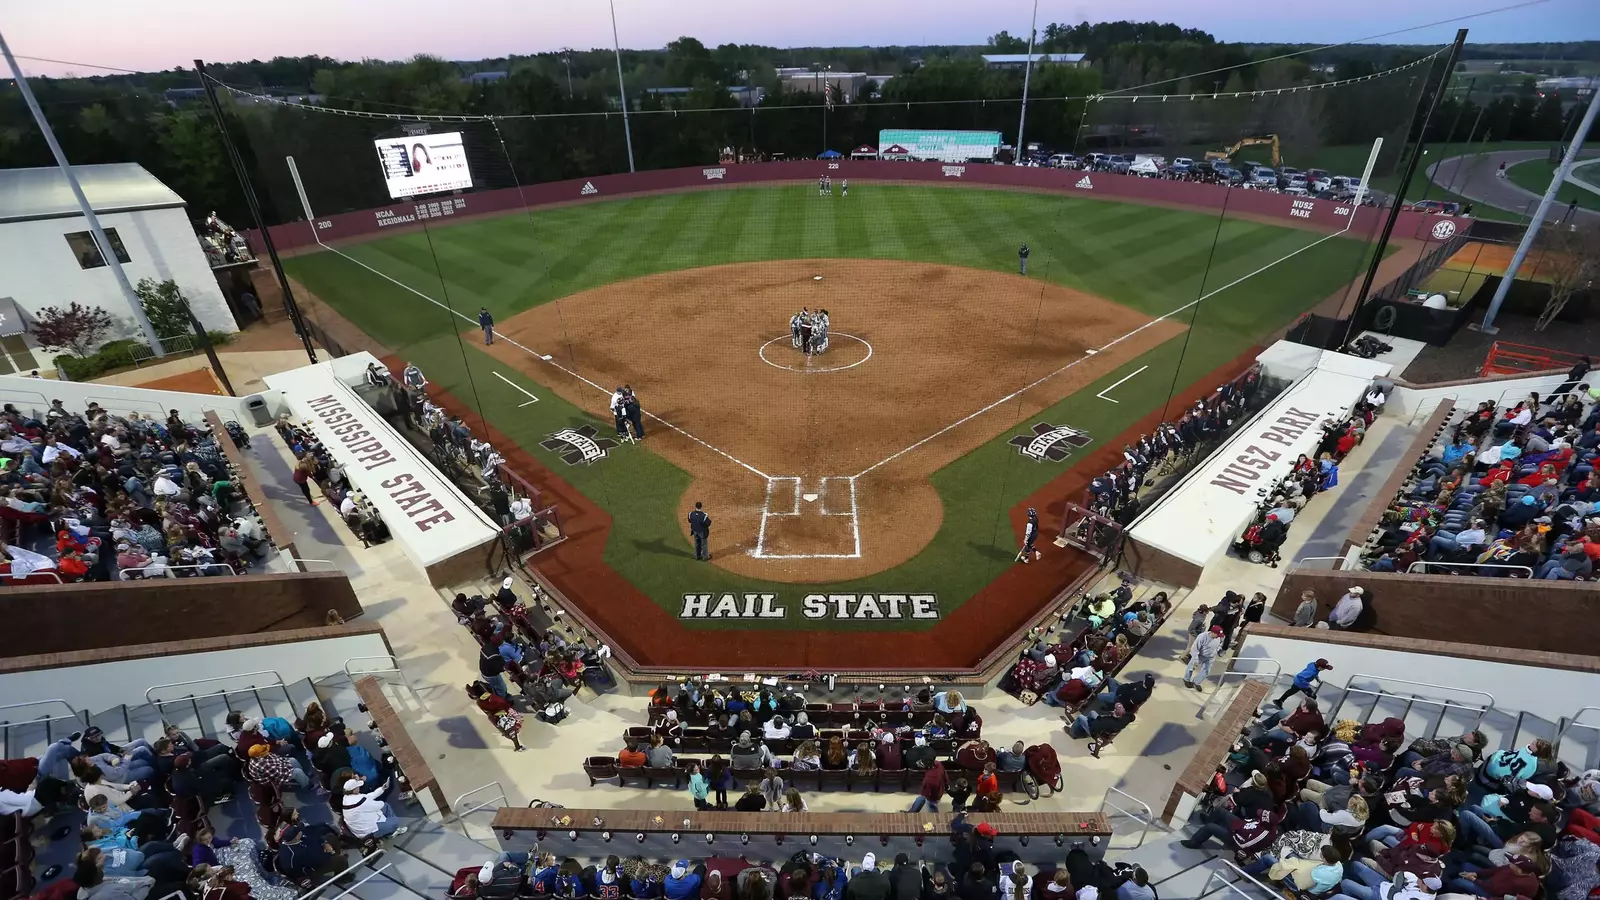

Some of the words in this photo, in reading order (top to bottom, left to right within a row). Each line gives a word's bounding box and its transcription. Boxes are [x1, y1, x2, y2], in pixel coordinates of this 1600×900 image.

[1292, 200, 1314, 210] NUSZ
[1333, 206, 1350, 216] 200
[374, 210, 395, 219] NCAA
[1290, 208, 1311, 218] PARK
[318, 220, 332, 229] 200
[378, 214, 416, 227] REGIONALS
[1433, 221, 1454, 238] SEC
[561, 433, 598, 456] STATE
[1031, 430, 1068, 453] STATE
[1210, 445, 1282, 495] NUSZ
[1260, 407, 1321, 447] PARK
[306, 394, 397, 471] MISSISSIPPI
[380, 473, 456, 532] STATE
[680, 594, 786, 618] HAIL
[802, 594, 940, 619] STATE
[600, 885, 619, 899] 33
